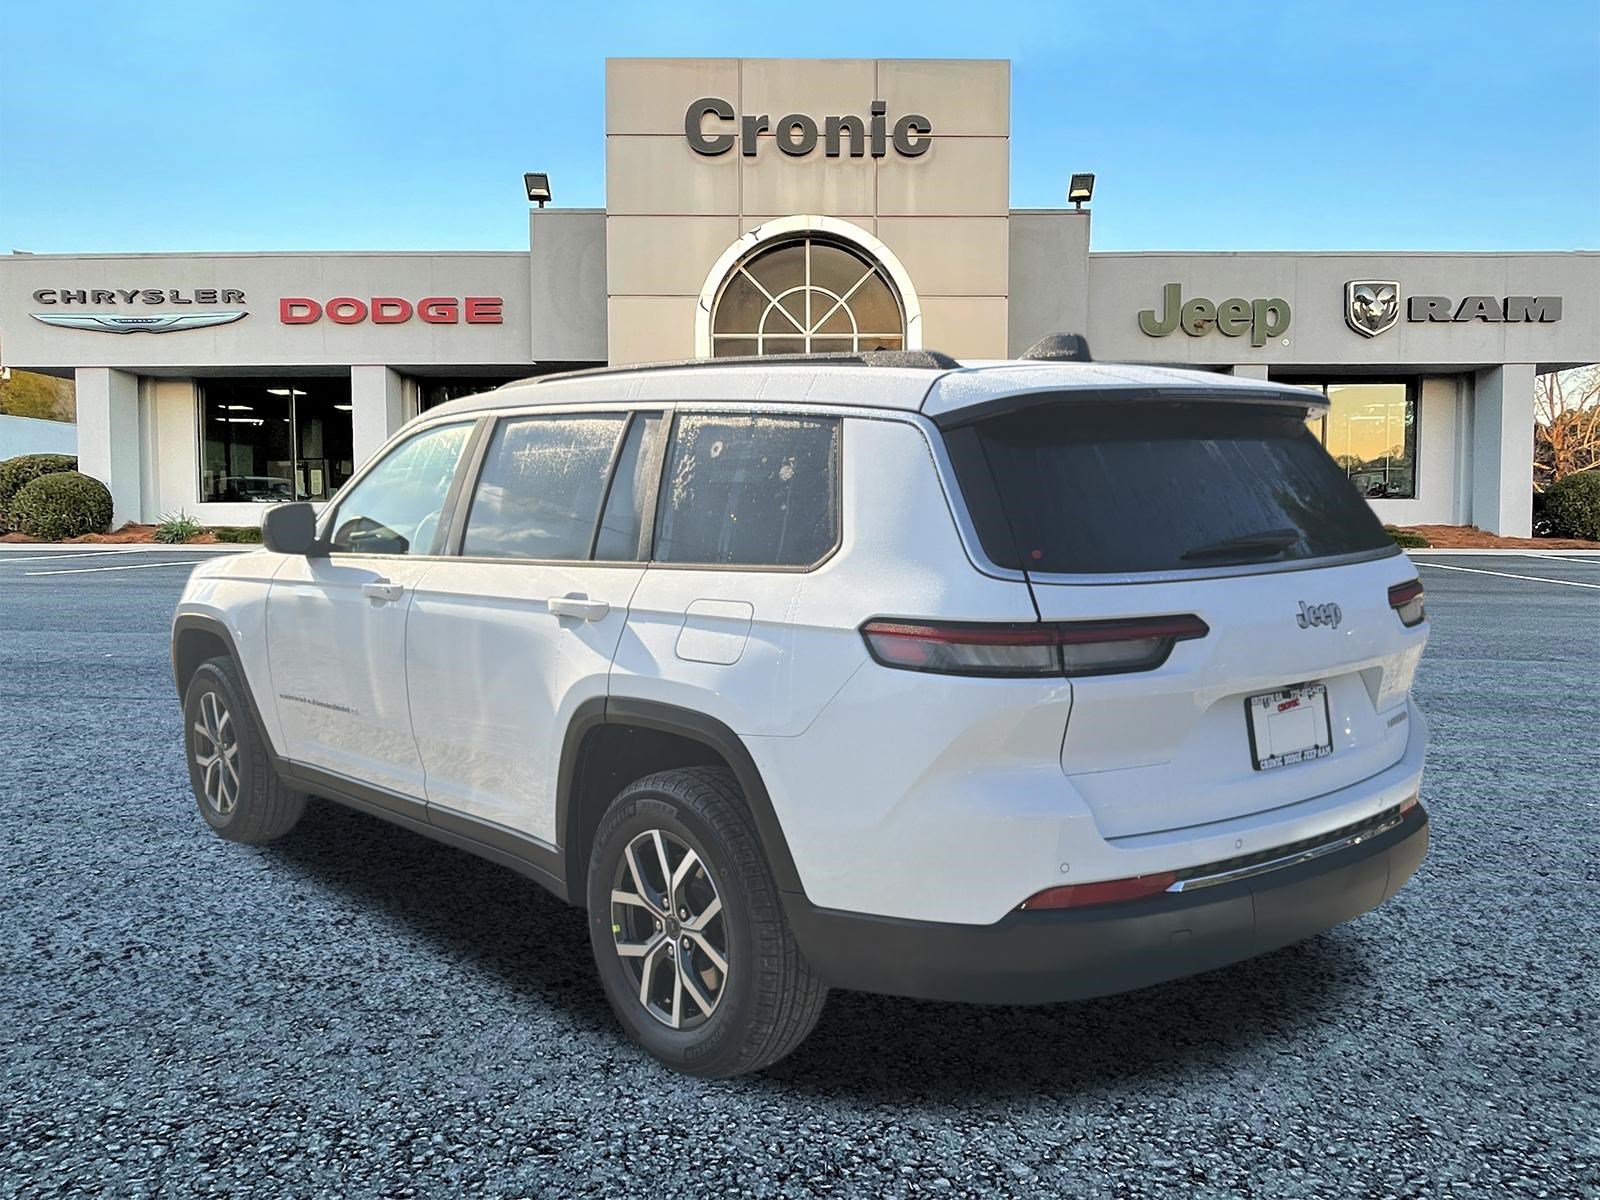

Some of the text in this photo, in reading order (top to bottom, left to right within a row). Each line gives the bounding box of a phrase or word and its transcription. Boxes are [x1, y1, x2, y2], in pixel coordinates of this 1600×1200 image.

[685, 97, 932, 158] Cronic
[32, 288, 246, 305] CHRYSLER
[280, 297, 503, 324] DODGE
[1407, 296, 1563, 323] RAM
[1138, 283, 1291, 347] Jeep
[1296, 600, 1342, 630] Jeep
